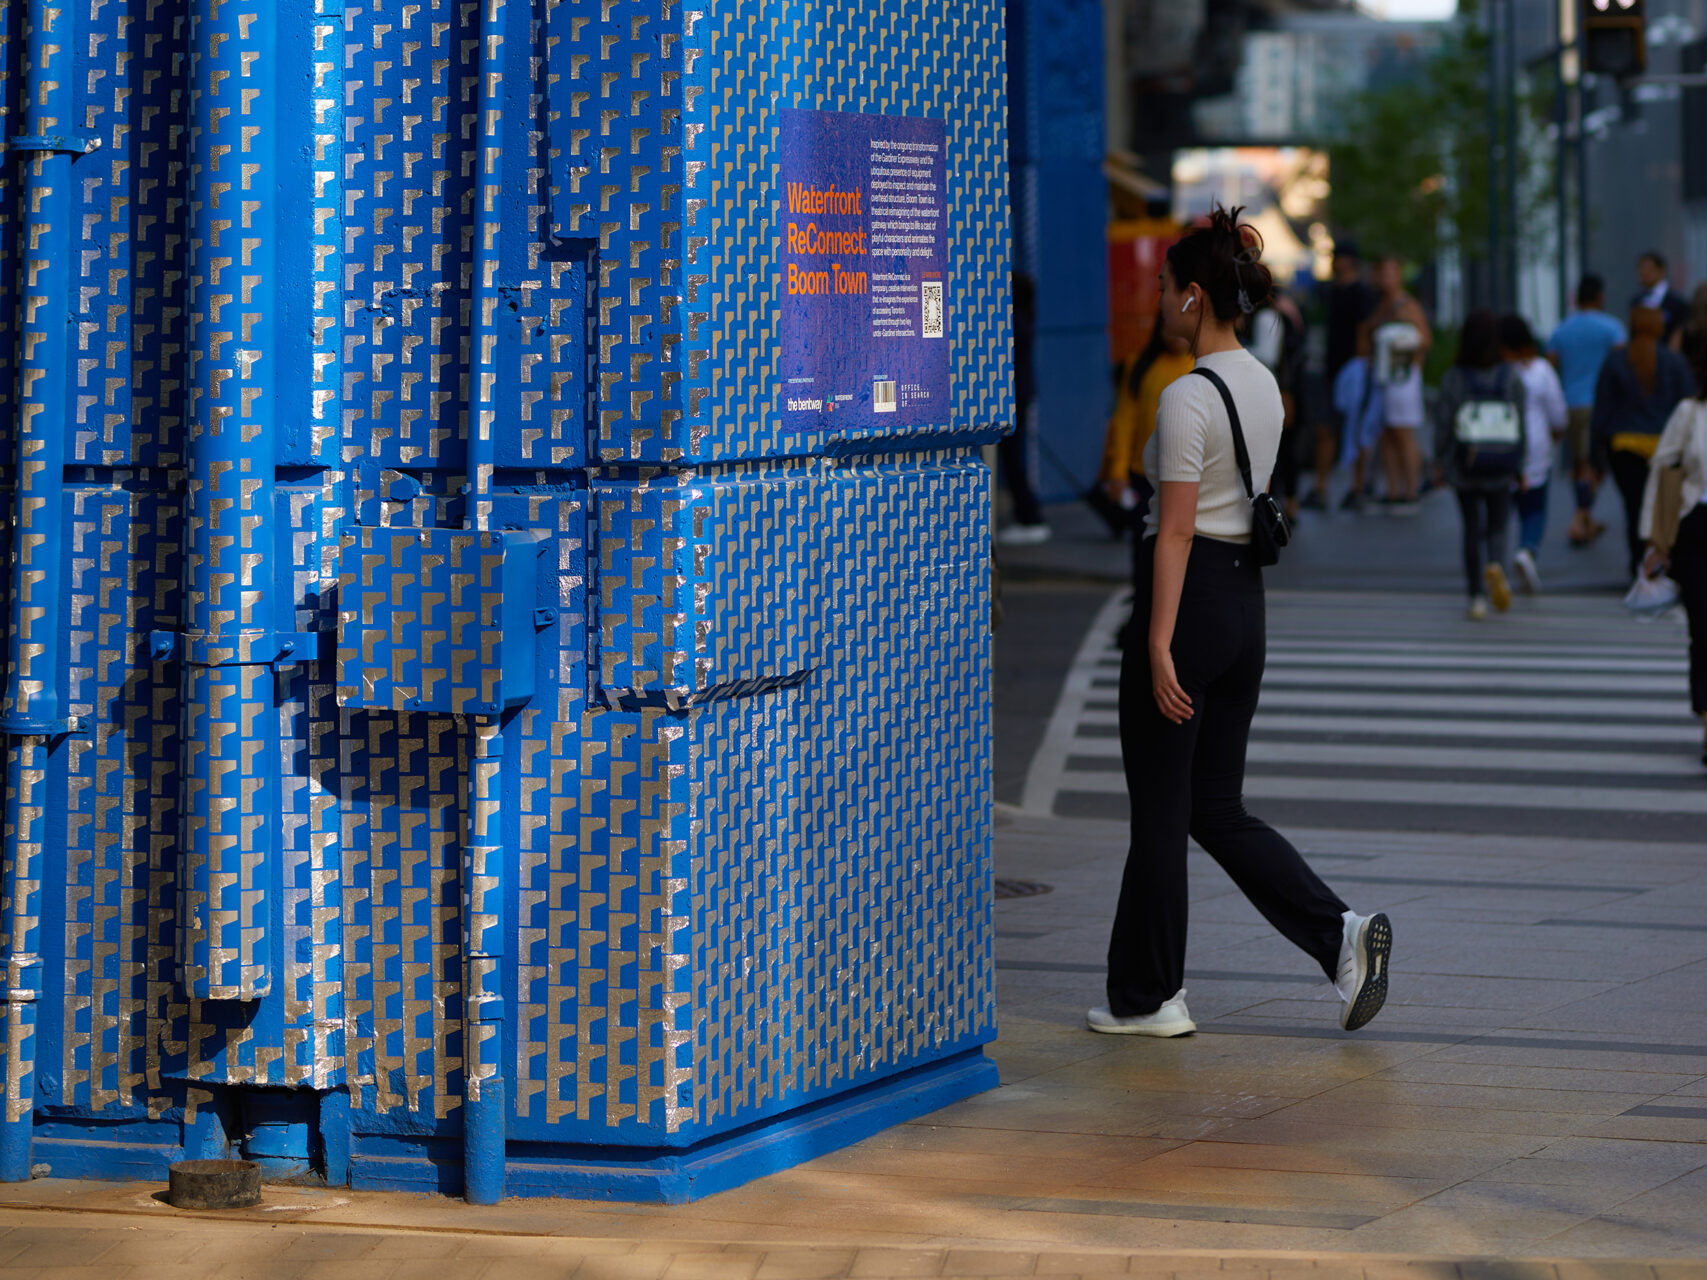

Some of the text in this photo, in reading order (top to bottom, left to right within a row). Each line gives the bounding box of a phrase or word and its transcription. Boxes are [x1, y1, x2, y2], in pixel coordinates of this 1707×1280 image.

[787, 182, 861, 215] Waterfront
[788, 222, 867, 255] ReConnect:
[788, 263, 867, 295] Boom Town
[788, 397, 797, 411] the
[798, 397, 823, 413] bentway
